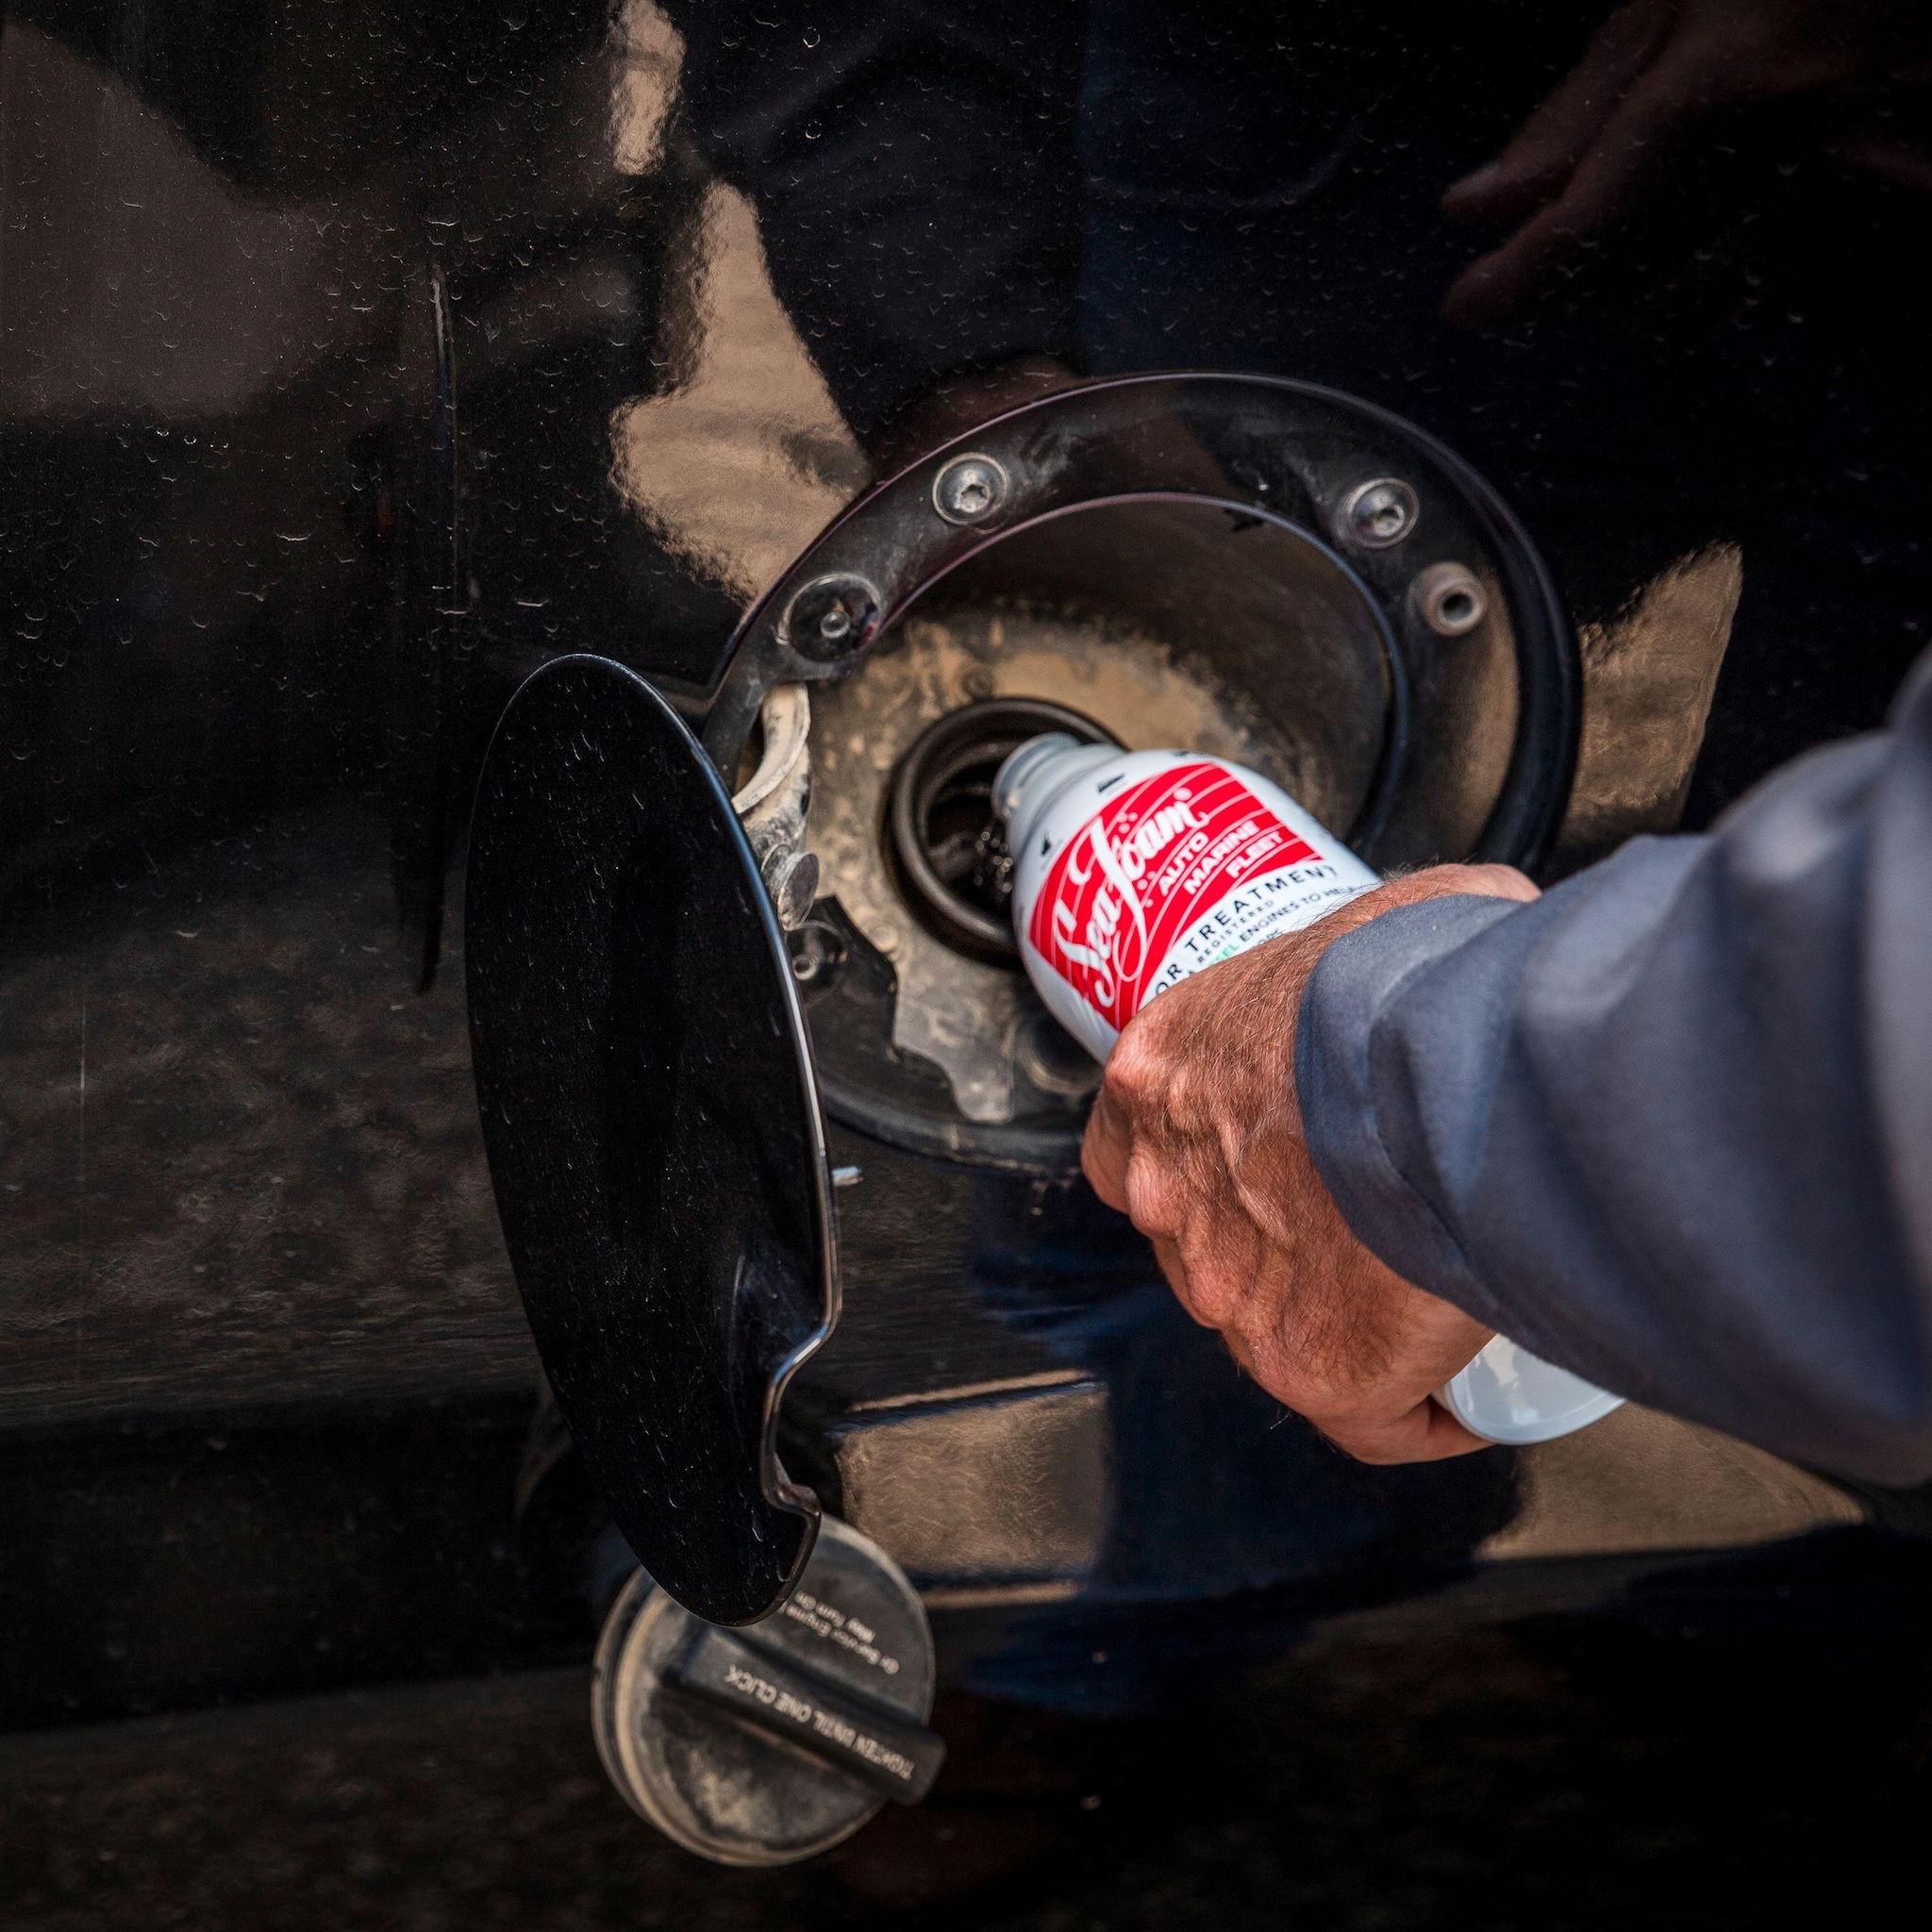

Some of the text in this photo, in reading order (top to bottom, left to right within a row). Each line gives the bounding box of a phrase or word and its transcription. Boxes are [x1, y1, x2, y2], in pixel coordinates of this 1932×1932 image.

[1158, 831, 1208, 896] AUTO
[1184, 821, 1260, 895] MARINE
[1227, 830, 1283, 878] FLEET
[1197, 901, 1274, 962] REGISTERED
[1240, 903, 1300, 941] ENGINES
[1301, 892, 1322, 910] TO
[723, 1664, 914, 1779] TIGHTEN UNTIL ONE CLICK
